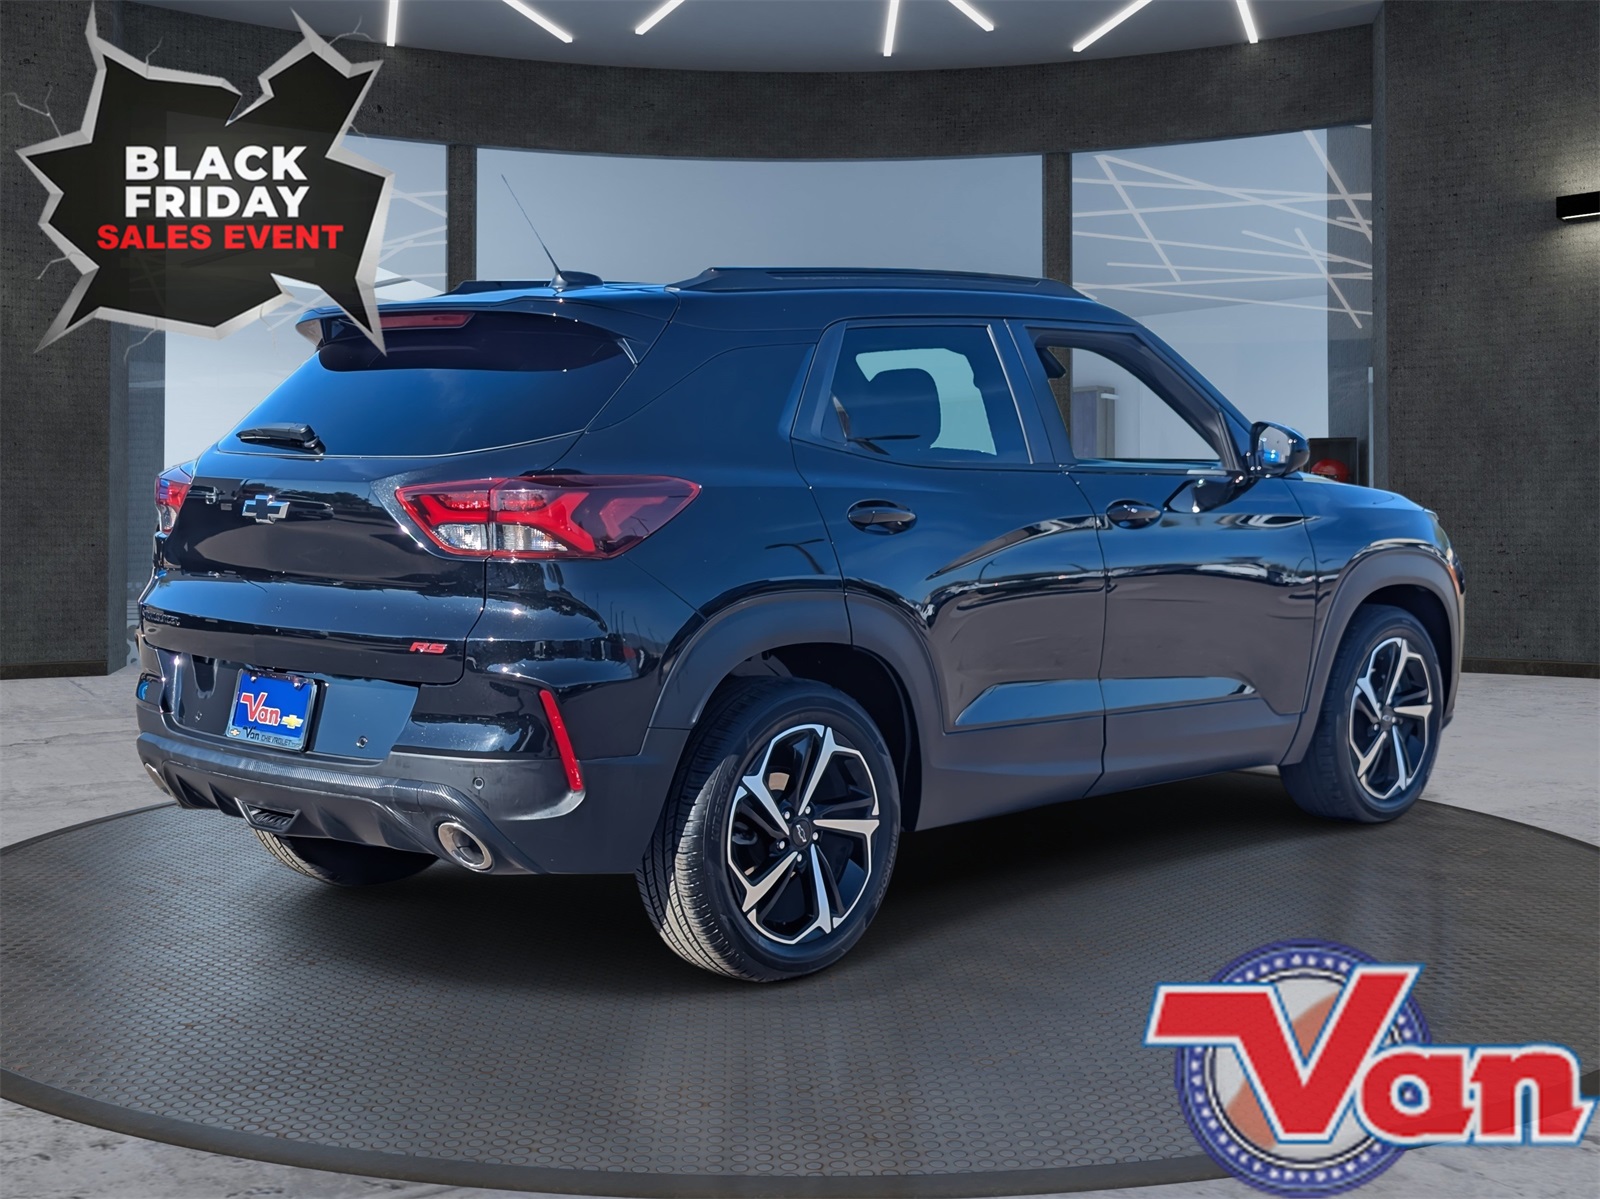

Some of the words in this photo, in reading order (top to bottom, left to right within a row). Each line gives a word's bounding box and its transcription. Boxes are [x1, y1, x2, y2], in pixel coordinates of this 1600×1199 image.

[409, 641, 448, 655] RS
[240, 692, 281, 726] Van
[243, 725, 260, 741] Van
